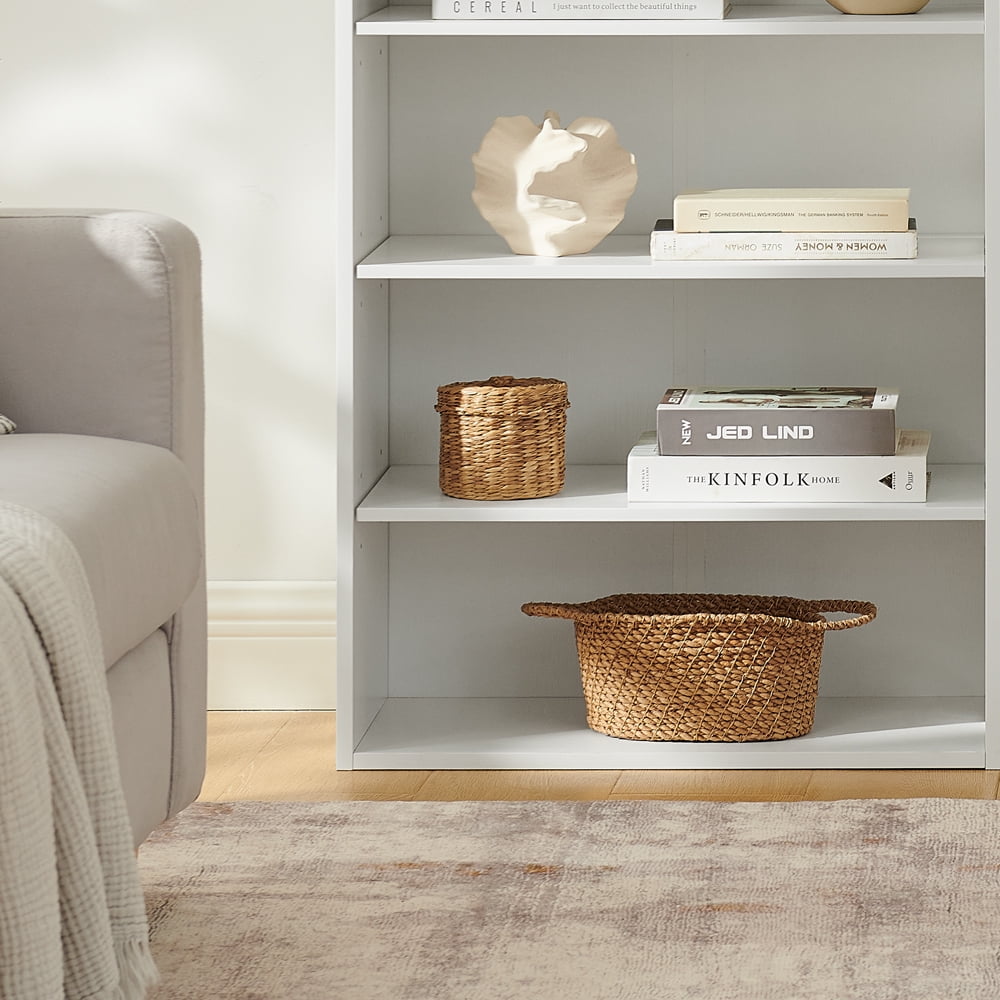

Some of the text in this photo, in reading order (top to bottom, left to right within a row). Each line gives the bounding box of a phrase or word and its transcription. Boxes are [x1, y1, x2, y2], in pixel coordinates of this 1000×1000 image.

[453, 1, 537, 13] CEREAL
[557, 3, 571, 11] just
[674, 3, 697, 11] things
[724, 242, 782, 250] SUZE ORMAN
[796, 242, 887, 250] WOMEN & MONEY
[681, 419, 692, 445] NEW
[706, 426, 814, 440] JED LIND
[708, 472, 810, 486] KINFOLK
